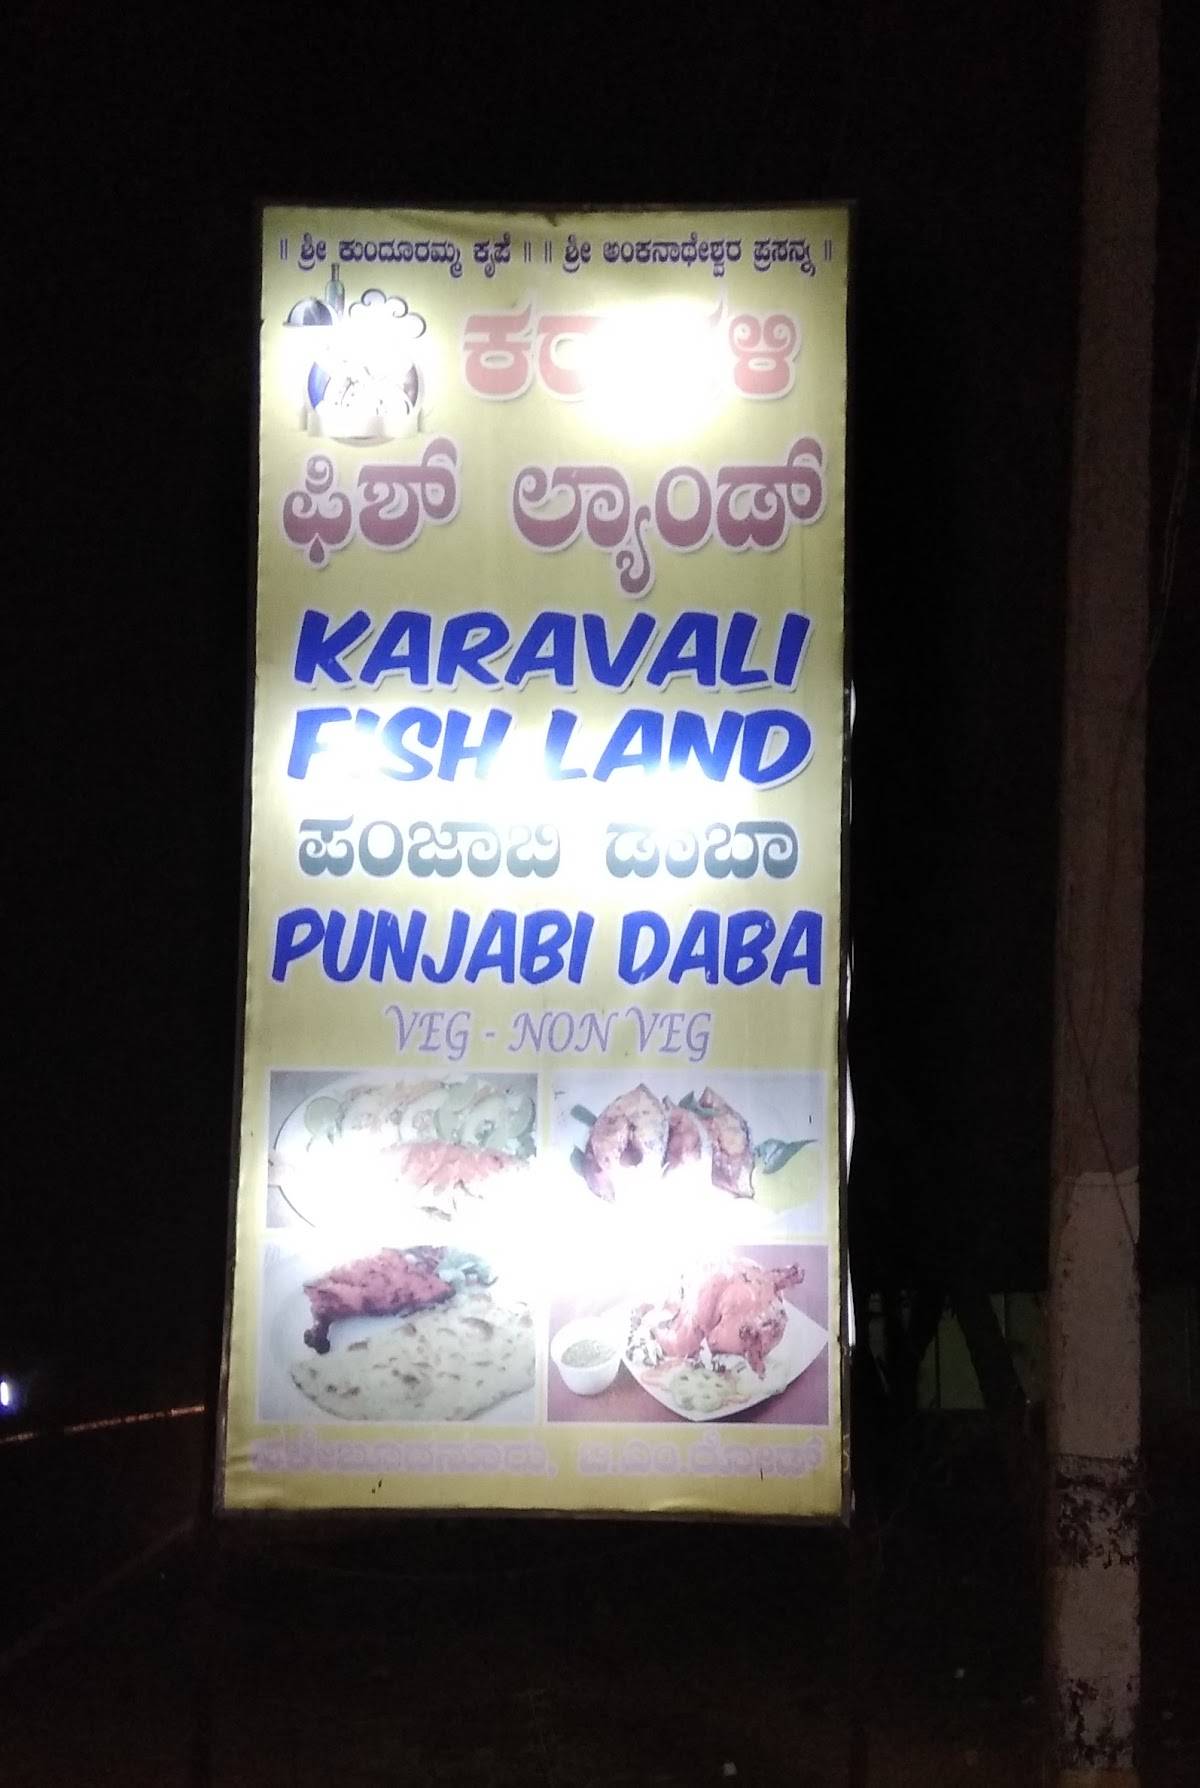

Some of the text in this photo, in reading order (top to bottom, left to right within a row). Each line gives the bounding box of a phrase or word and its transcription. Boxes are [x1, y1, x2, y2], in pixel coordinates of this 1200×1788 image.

[298, 232, 327, 270] ಶ್ರೀ
[338, 238, 463, 279] ಕುಂದೂರಮ್ಮ
[473, 232, 512, 278] ಕೃಪೆ
[562, 233, 592, 273] ಶ್ರೀ
[753, 238, 816, 277] ಪ್ರಸನ್ನ
[282, 435, 824, 596] ಫಿಶ್ ಲ್ಯಾಂಡ್
[293, 607, 811, 689] KARAVALI
[286, 706, 813, 786] FSH LAND
[270, 907, 824, 987] PUNJABI DABA
[385, 1003, 472, 1063] VEG
[508, 1010, 618, 1054] NON
[624, 1005, 714, 1064] VEG
